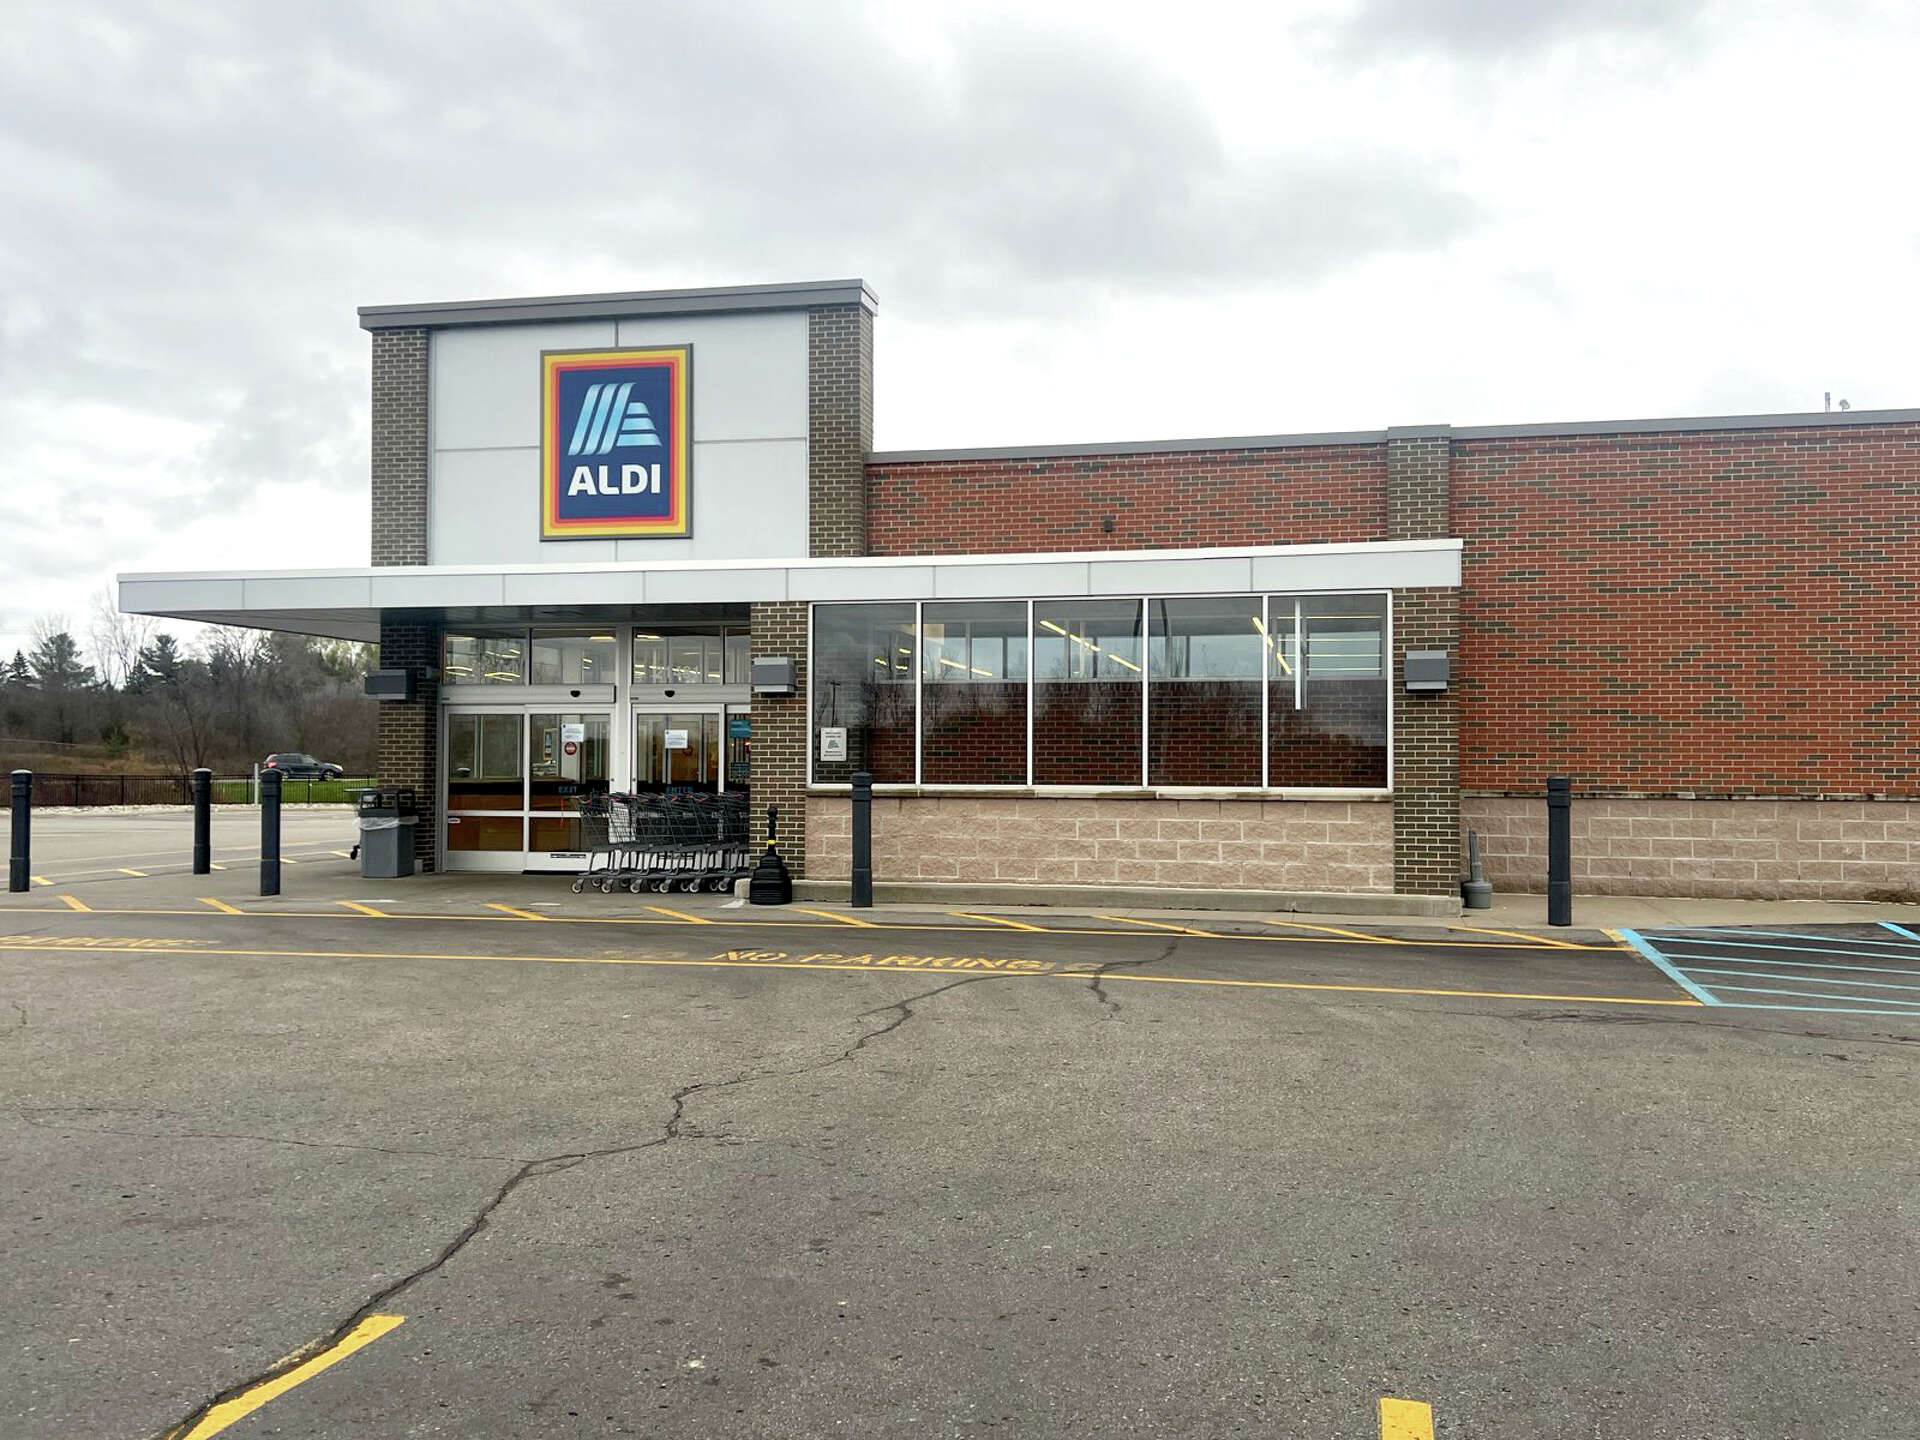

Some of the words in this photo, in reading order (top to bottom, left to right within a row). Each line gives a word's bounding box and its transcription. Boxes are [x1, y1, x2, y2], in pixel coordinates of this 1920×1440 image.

[567, 463, 661, 496] ALDI
[558, 785, 577, 794] EXIT
[709, 951, 787, 961] NO
[799, 953, 1045, 970] PARKING
